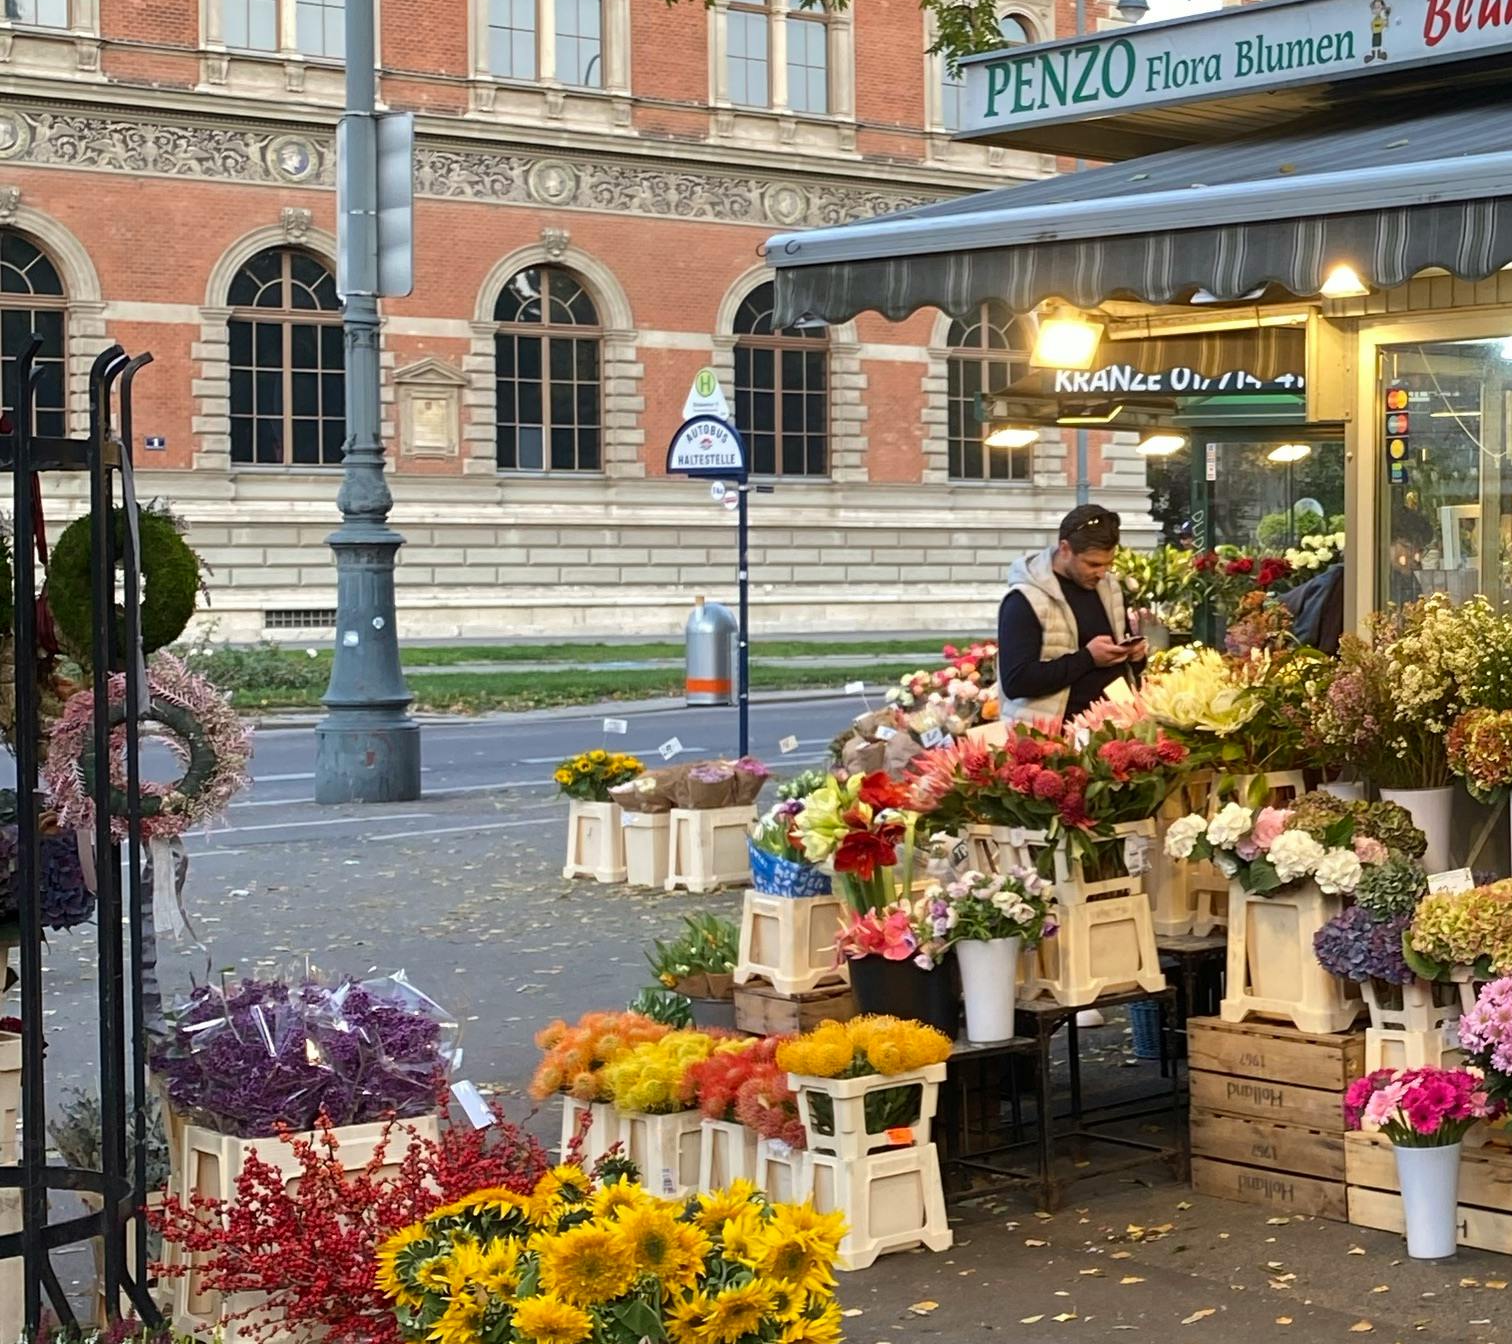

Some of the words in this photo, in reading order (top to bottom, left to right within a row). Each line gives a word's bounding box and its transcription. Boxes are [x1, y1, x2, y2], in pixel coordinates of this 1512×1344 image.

[983, 37, 1137, 118] PENZO
[1145, 50, 1222, 93] Flora
[1234, 29, 1355, 80] Blumen
[686, 424, 728, 445] AUTOBUS
[678, 453, 736, 466] HALTESTELLE
[1226, 1081, 1284, 1108] Holland
[1237, 1174, 1295, 1202] Holland
